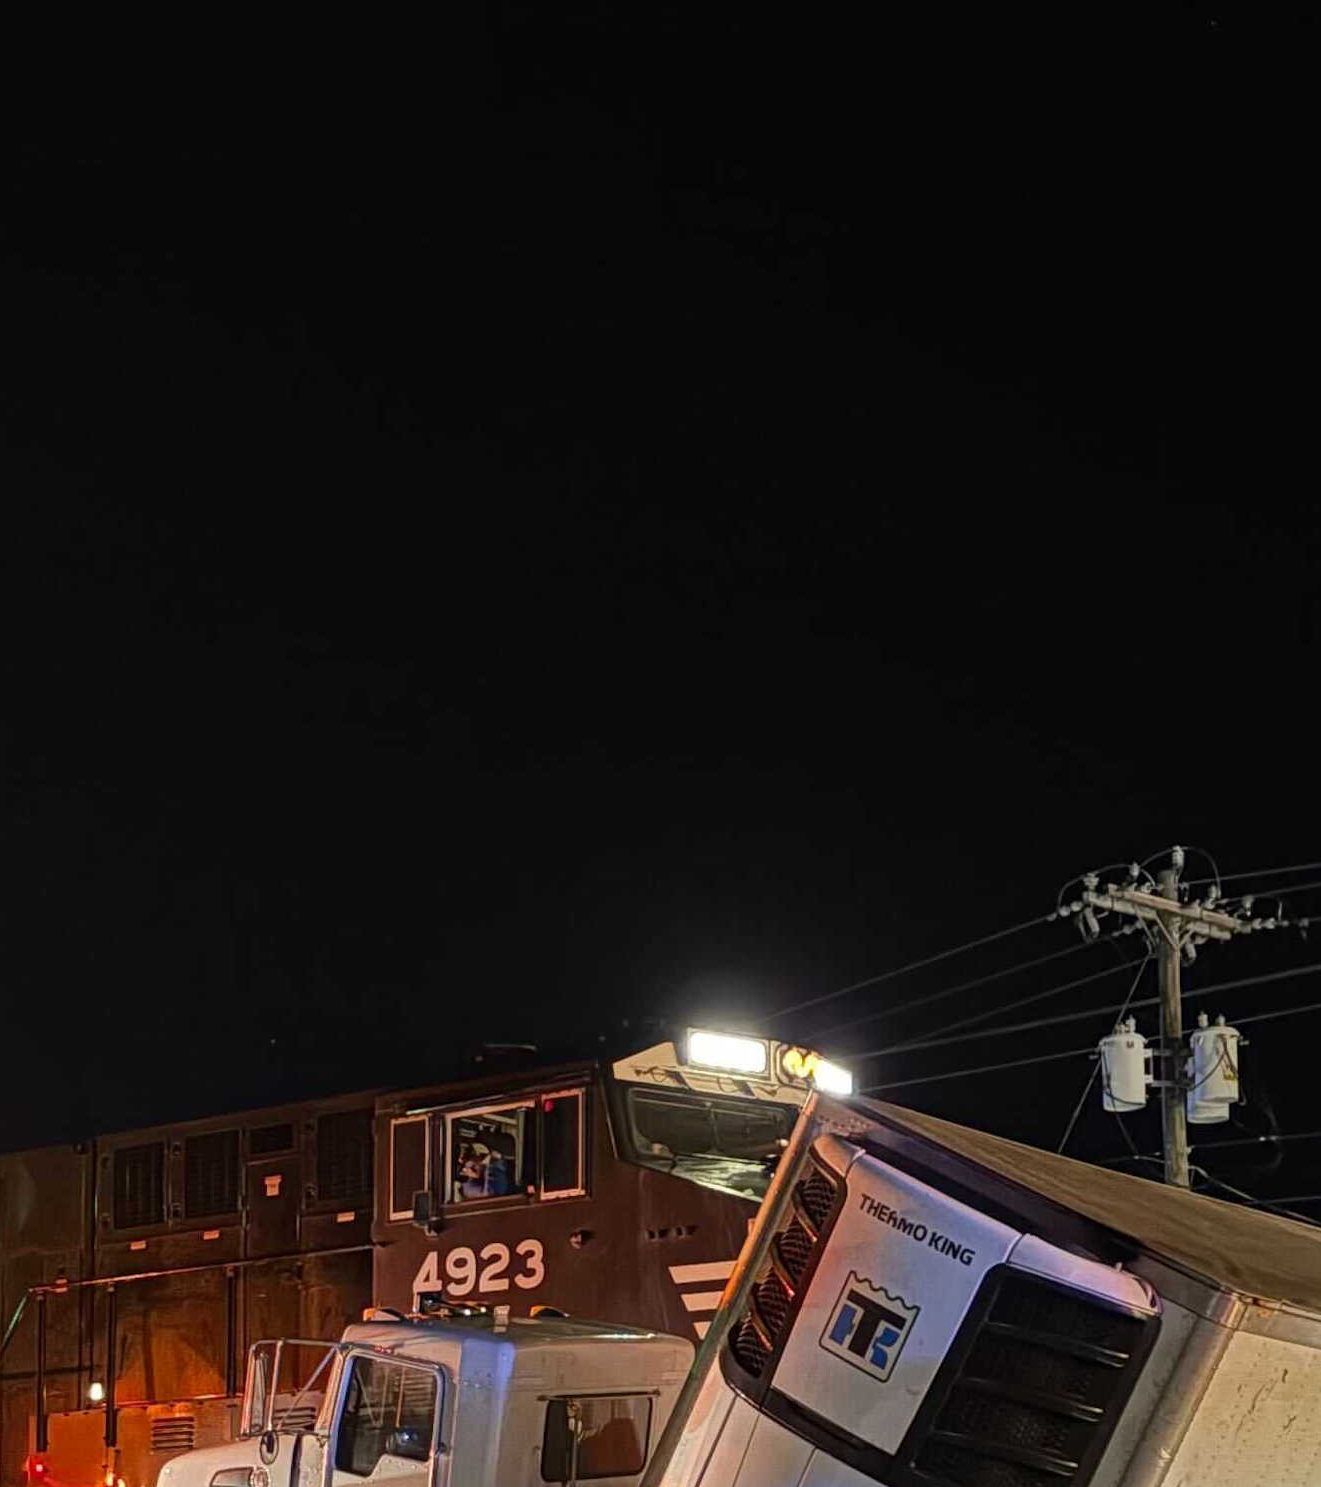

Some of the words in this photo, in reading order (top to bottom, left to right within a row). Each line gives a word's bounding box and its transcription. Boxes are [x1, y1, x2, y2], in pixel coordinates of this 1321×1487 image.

[859, 1193, 928, 1242] THERMO
[927, 1231, 976, 1267] KING
[412, 1239, 545, 1296] 4923
